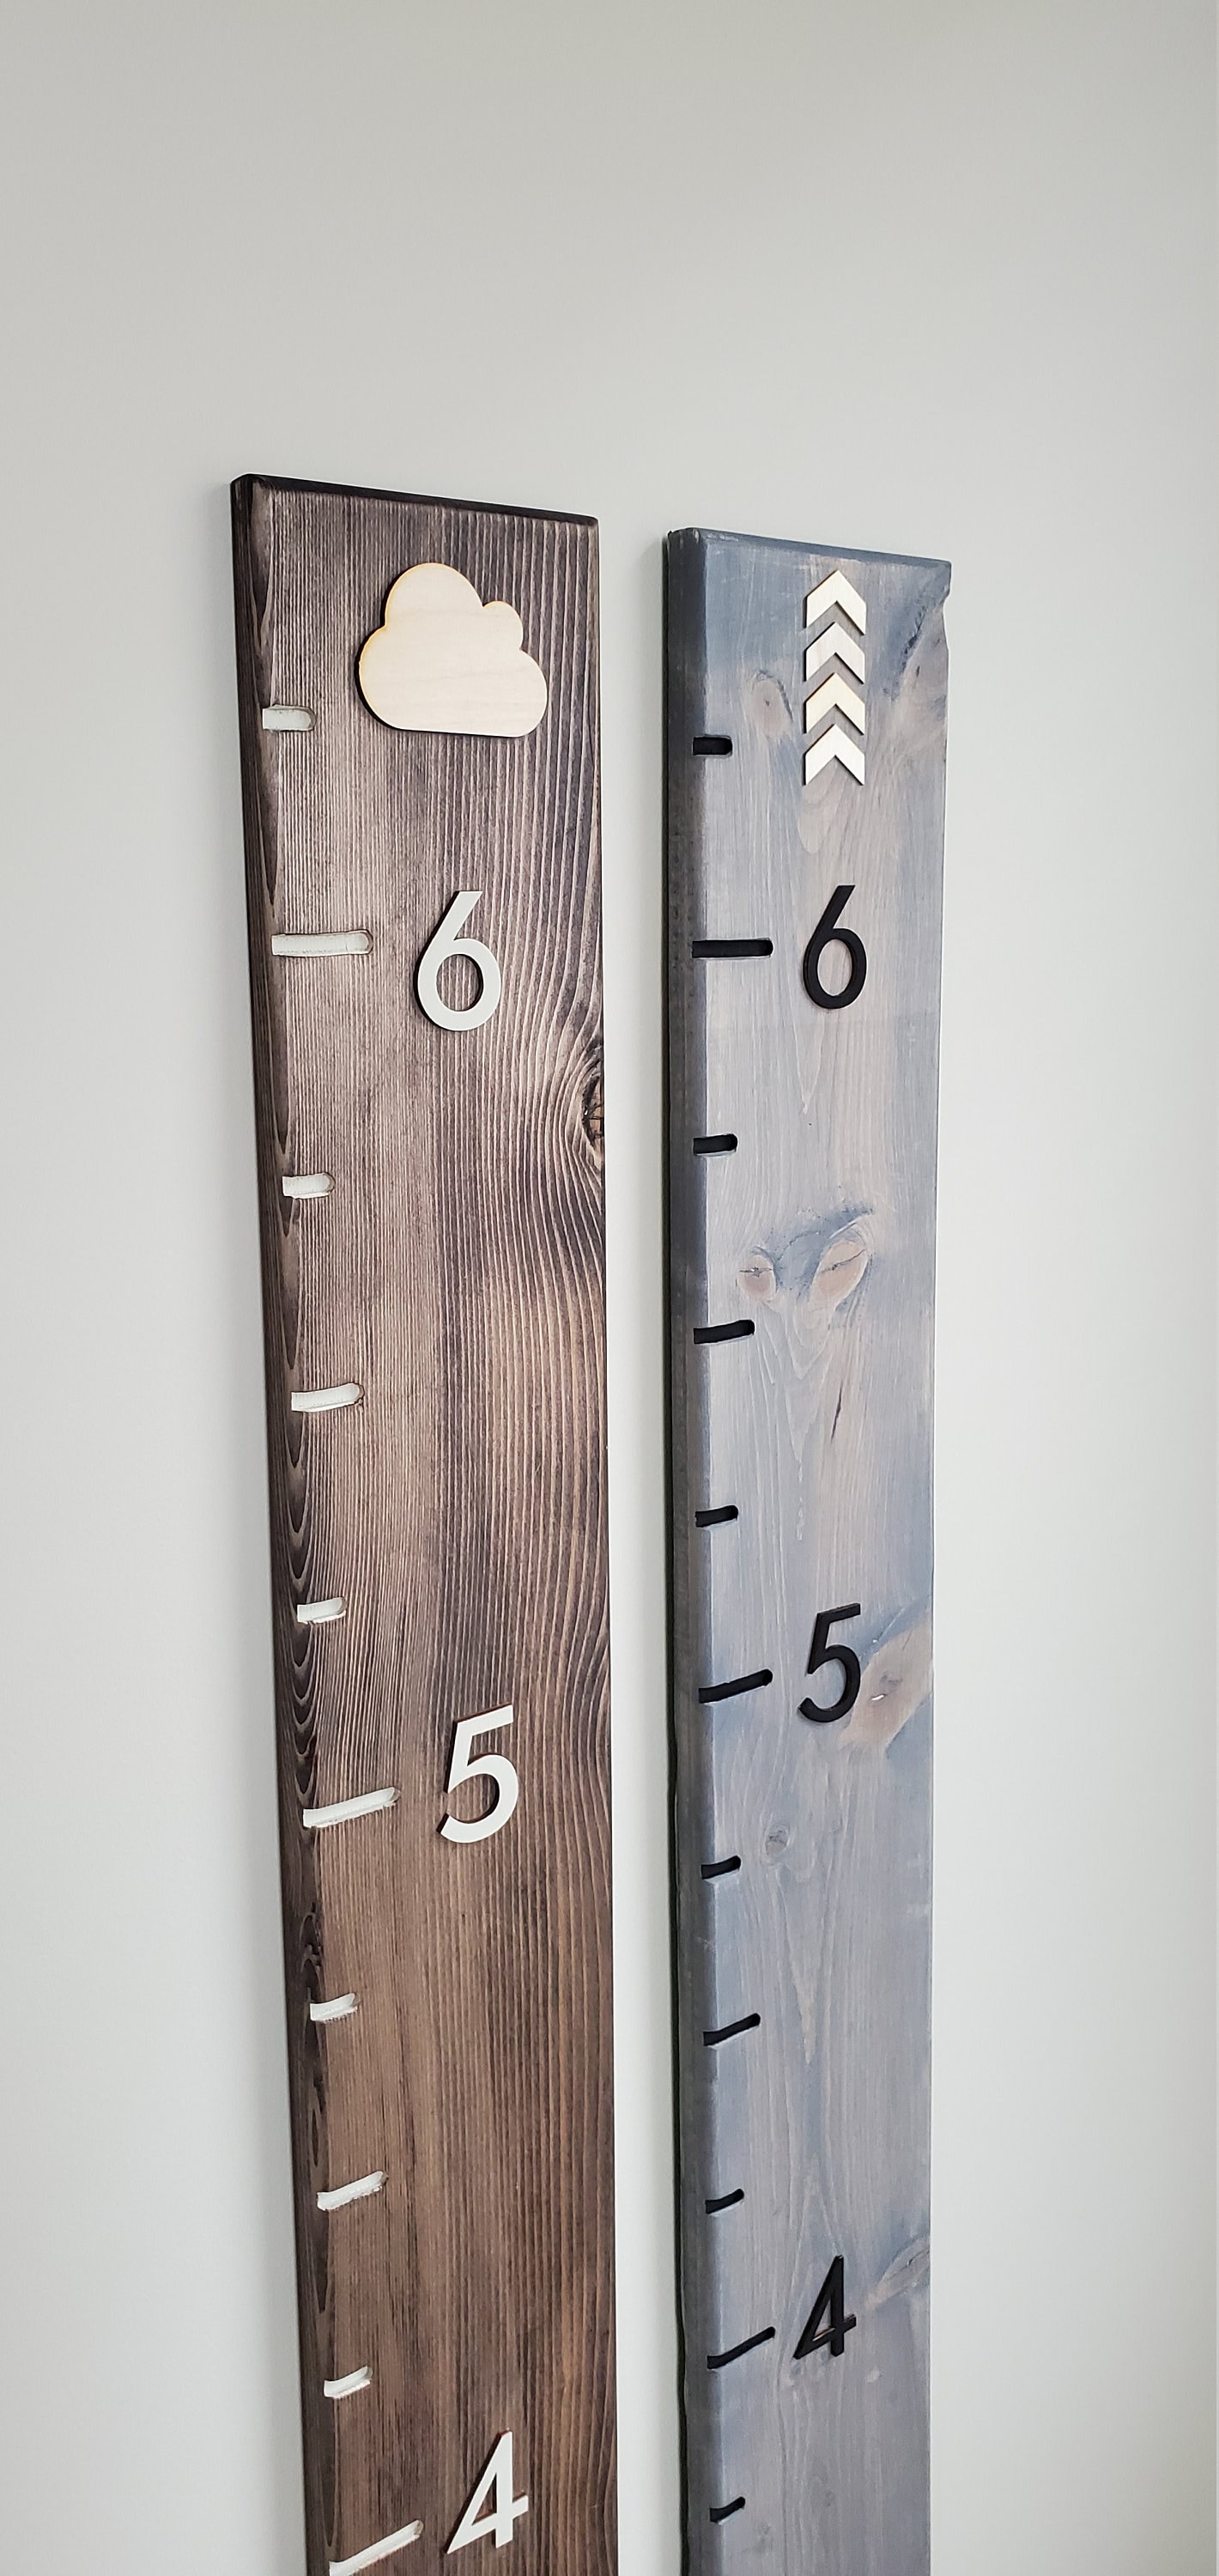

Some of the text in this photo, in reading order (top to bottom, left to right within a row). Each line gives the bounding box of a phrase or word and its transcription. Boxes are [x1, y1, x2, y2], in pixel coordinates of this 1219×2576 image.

[415, 890, 500, 1032] 6
[803, 884, 867, 1010] 6
[797, 1603, 862, 1723] 5
[436, 1704, 519, 1844] 5
[792, 2255, 857, 2360] 4
[446, 2429, 530, 2555] 4
